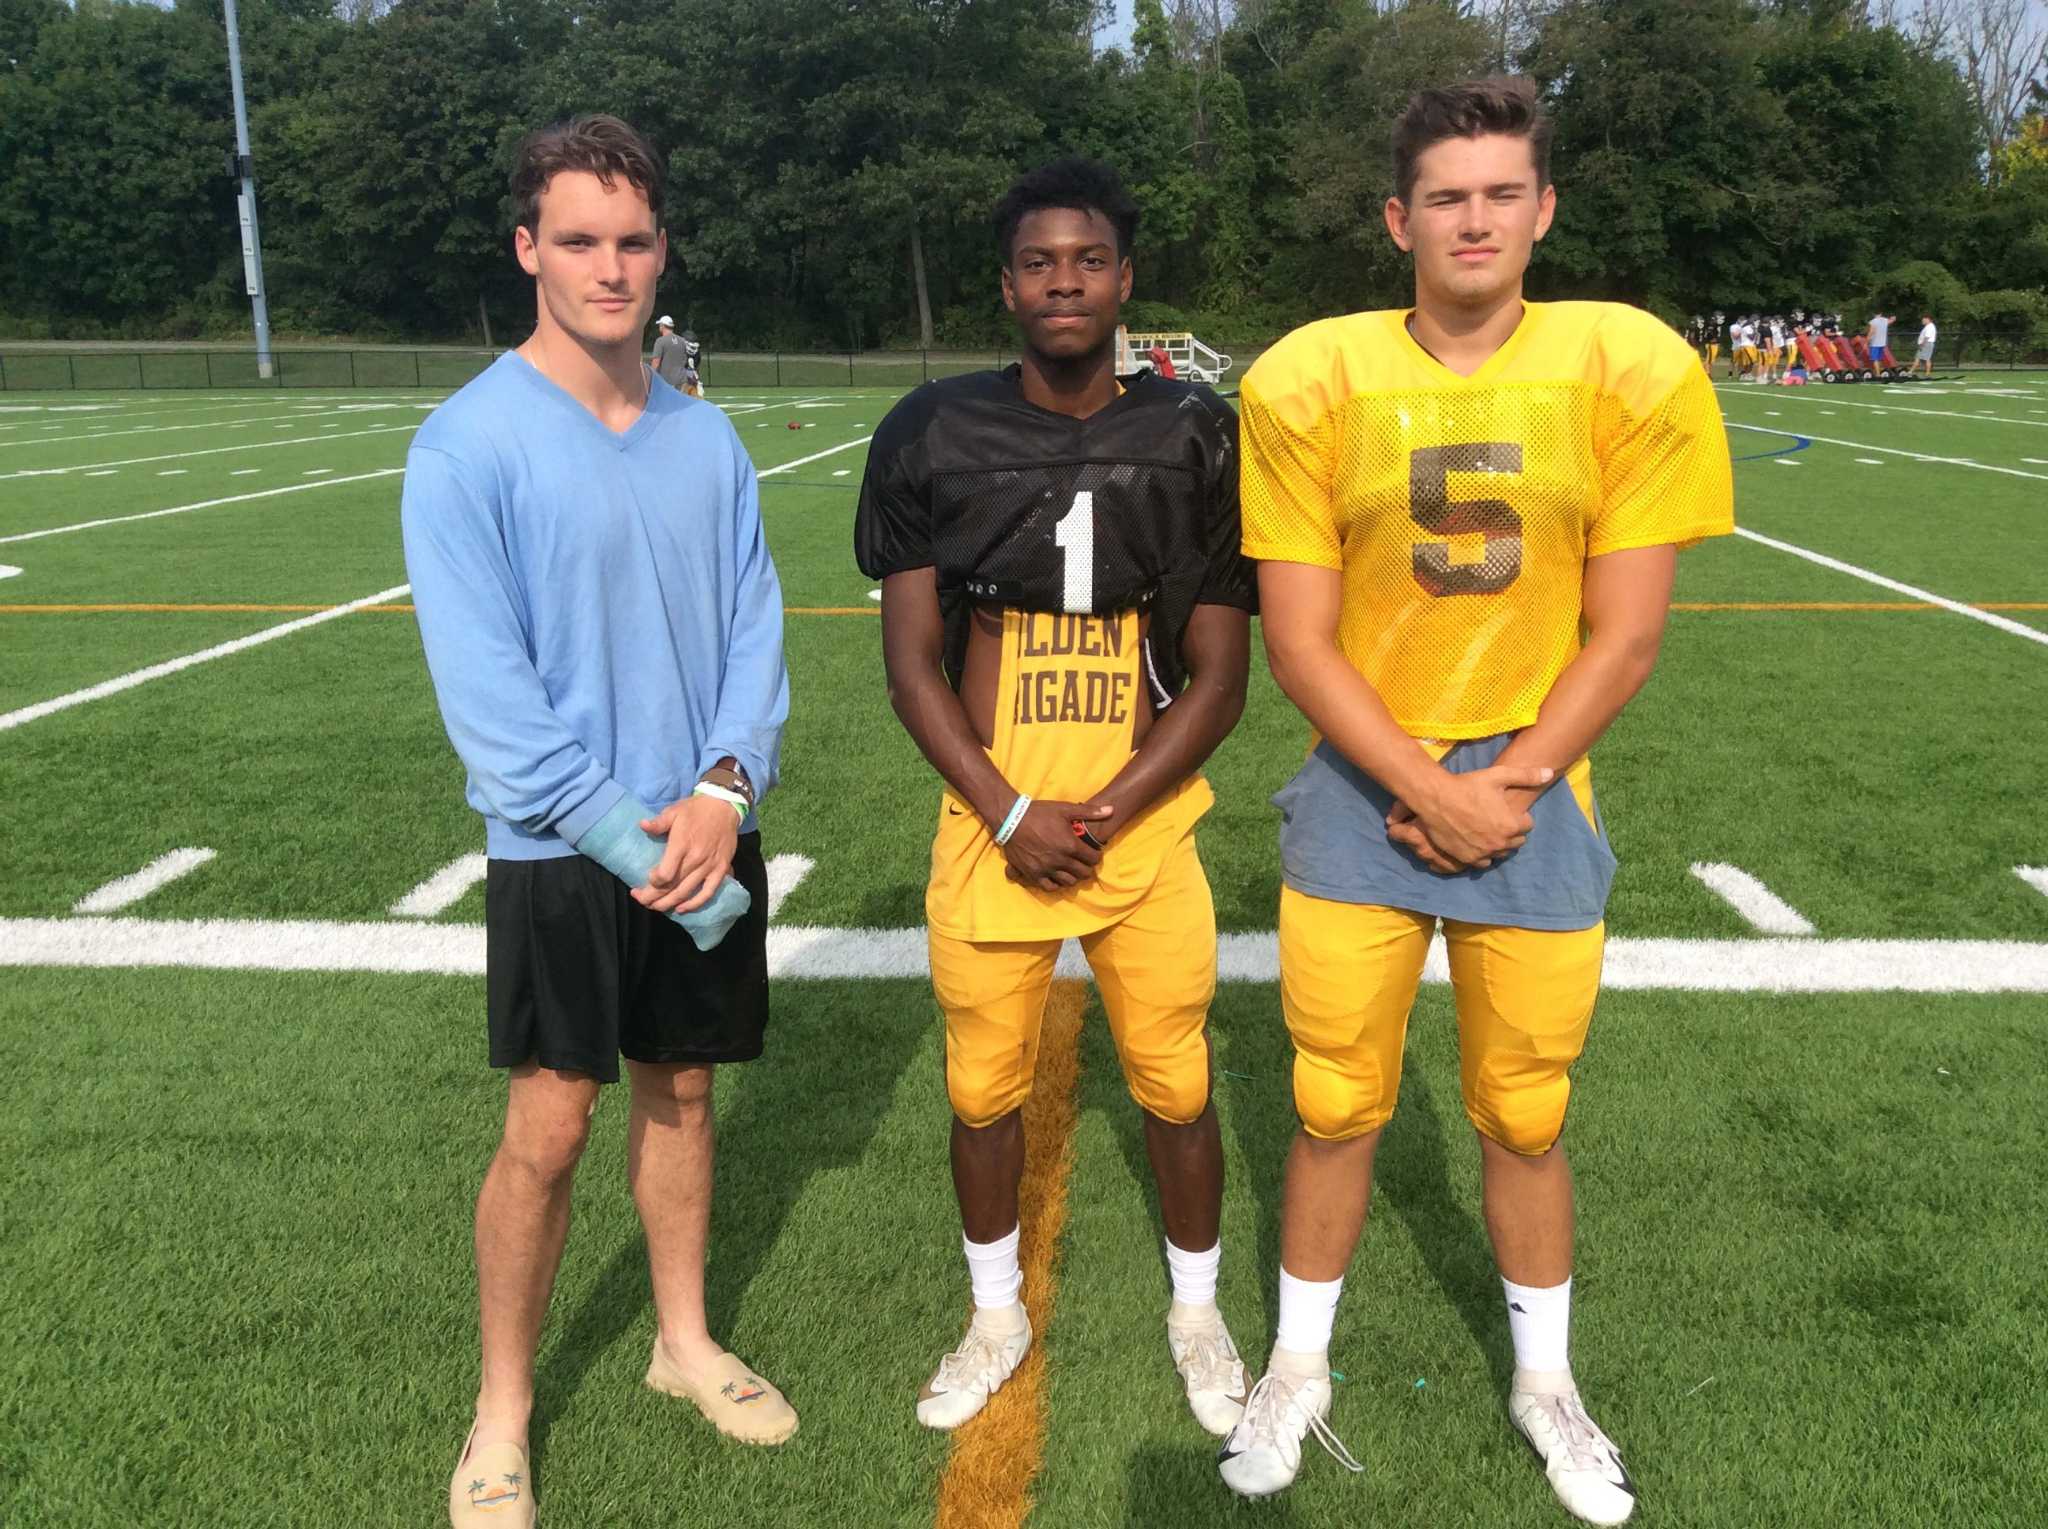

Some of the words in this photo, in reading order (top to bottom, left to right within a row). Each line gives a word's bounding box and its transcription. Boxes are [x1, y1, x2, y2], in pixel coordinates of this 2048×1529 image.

[1056, 491, 1093, 614] 1
[1409, 441, 1523, 597] 5
[1017, 614, 1122, 657] LDEN
[1014, 670, 1131, 725] IGADE
